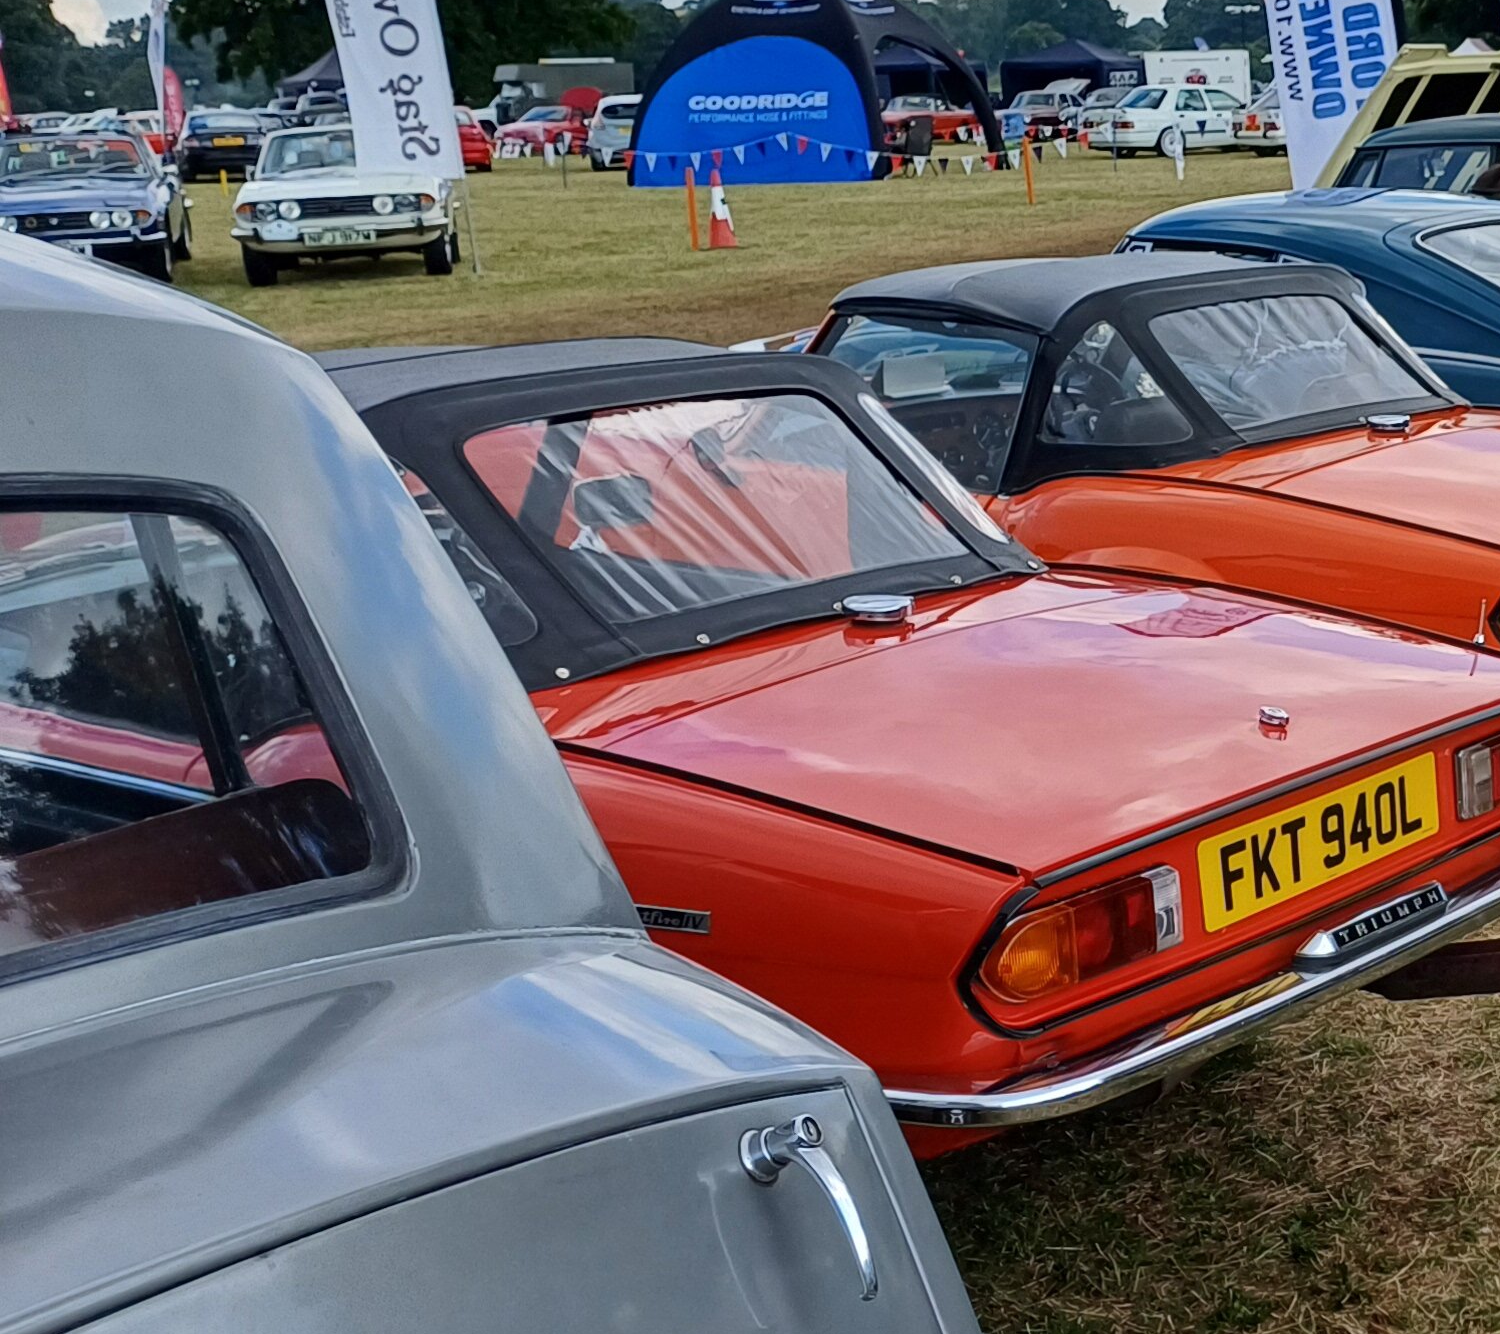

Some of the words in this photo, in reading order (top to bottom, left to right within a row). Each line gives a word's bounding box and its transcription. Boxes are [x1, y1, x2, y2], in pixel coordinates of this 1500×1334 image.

[688, 90, 829, 111] GOODRIDGE
[1219, 815, 1307, 913] FKT
[1320, 775, 1423, 870] 940L
[1338, 889, 1439, 944] TRIUMPH
